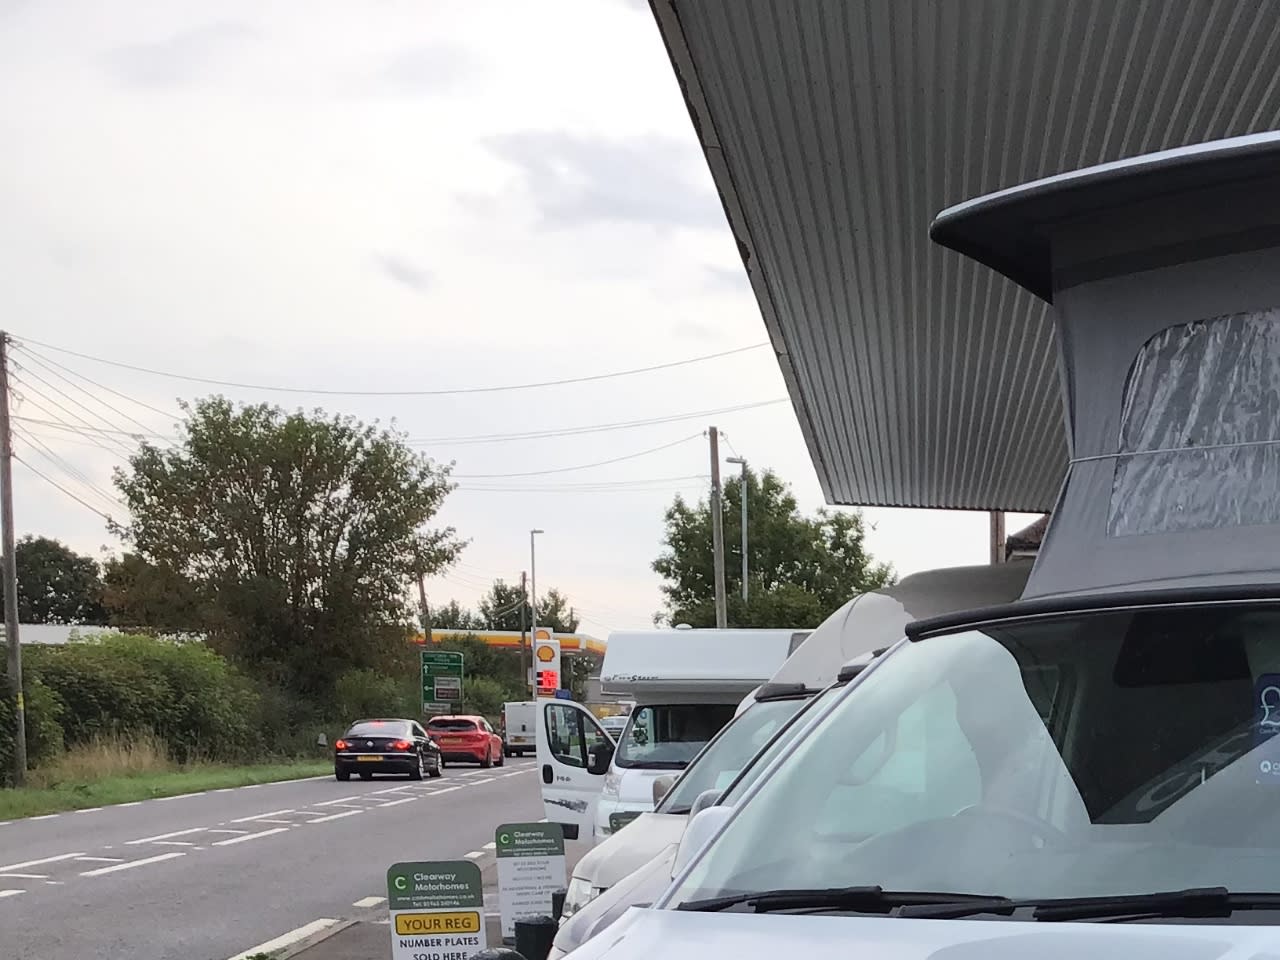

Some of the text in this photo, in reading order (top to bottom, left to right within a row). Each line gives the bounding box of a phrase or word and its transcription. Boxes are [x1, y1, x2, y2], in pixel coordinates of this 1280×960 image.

[413, 873, 456, 882] Clearway
[414, 883, 470, 892] Motorhomes
[403, 917, 472, 931] YOUR REG
[399, 936, 480, 948] NUMBER PLATES
[442, 951, 468, 960] HERE
